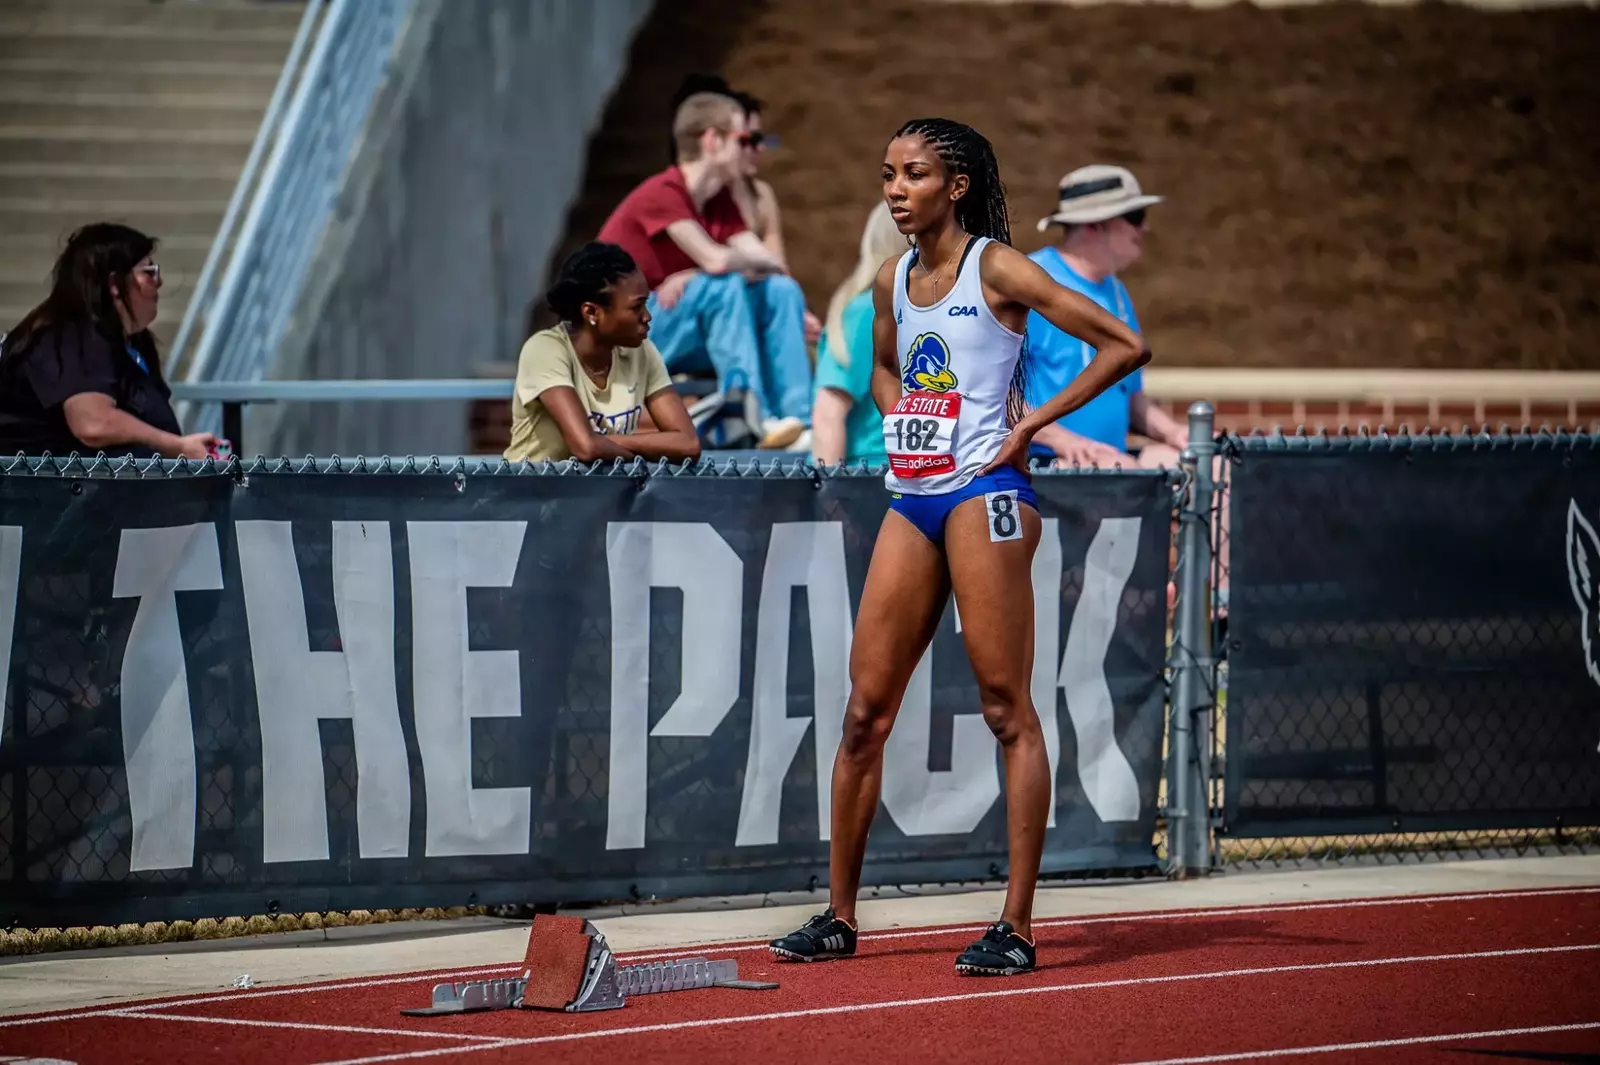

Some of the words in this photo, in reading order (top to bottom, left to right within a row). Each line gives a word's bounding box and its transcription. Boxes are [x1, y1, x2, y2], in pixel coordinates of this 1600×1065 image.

[948, 306, 978, 317] CAA
[893, 397, 911, 413] NC
[910, 397, 951, 416] STATE
[893, 418, 940, 451] 182
[908, 456, 950, 469] adidas
[992, 494, 1016, 538] 8
[113, 520, 531, 871] THE
